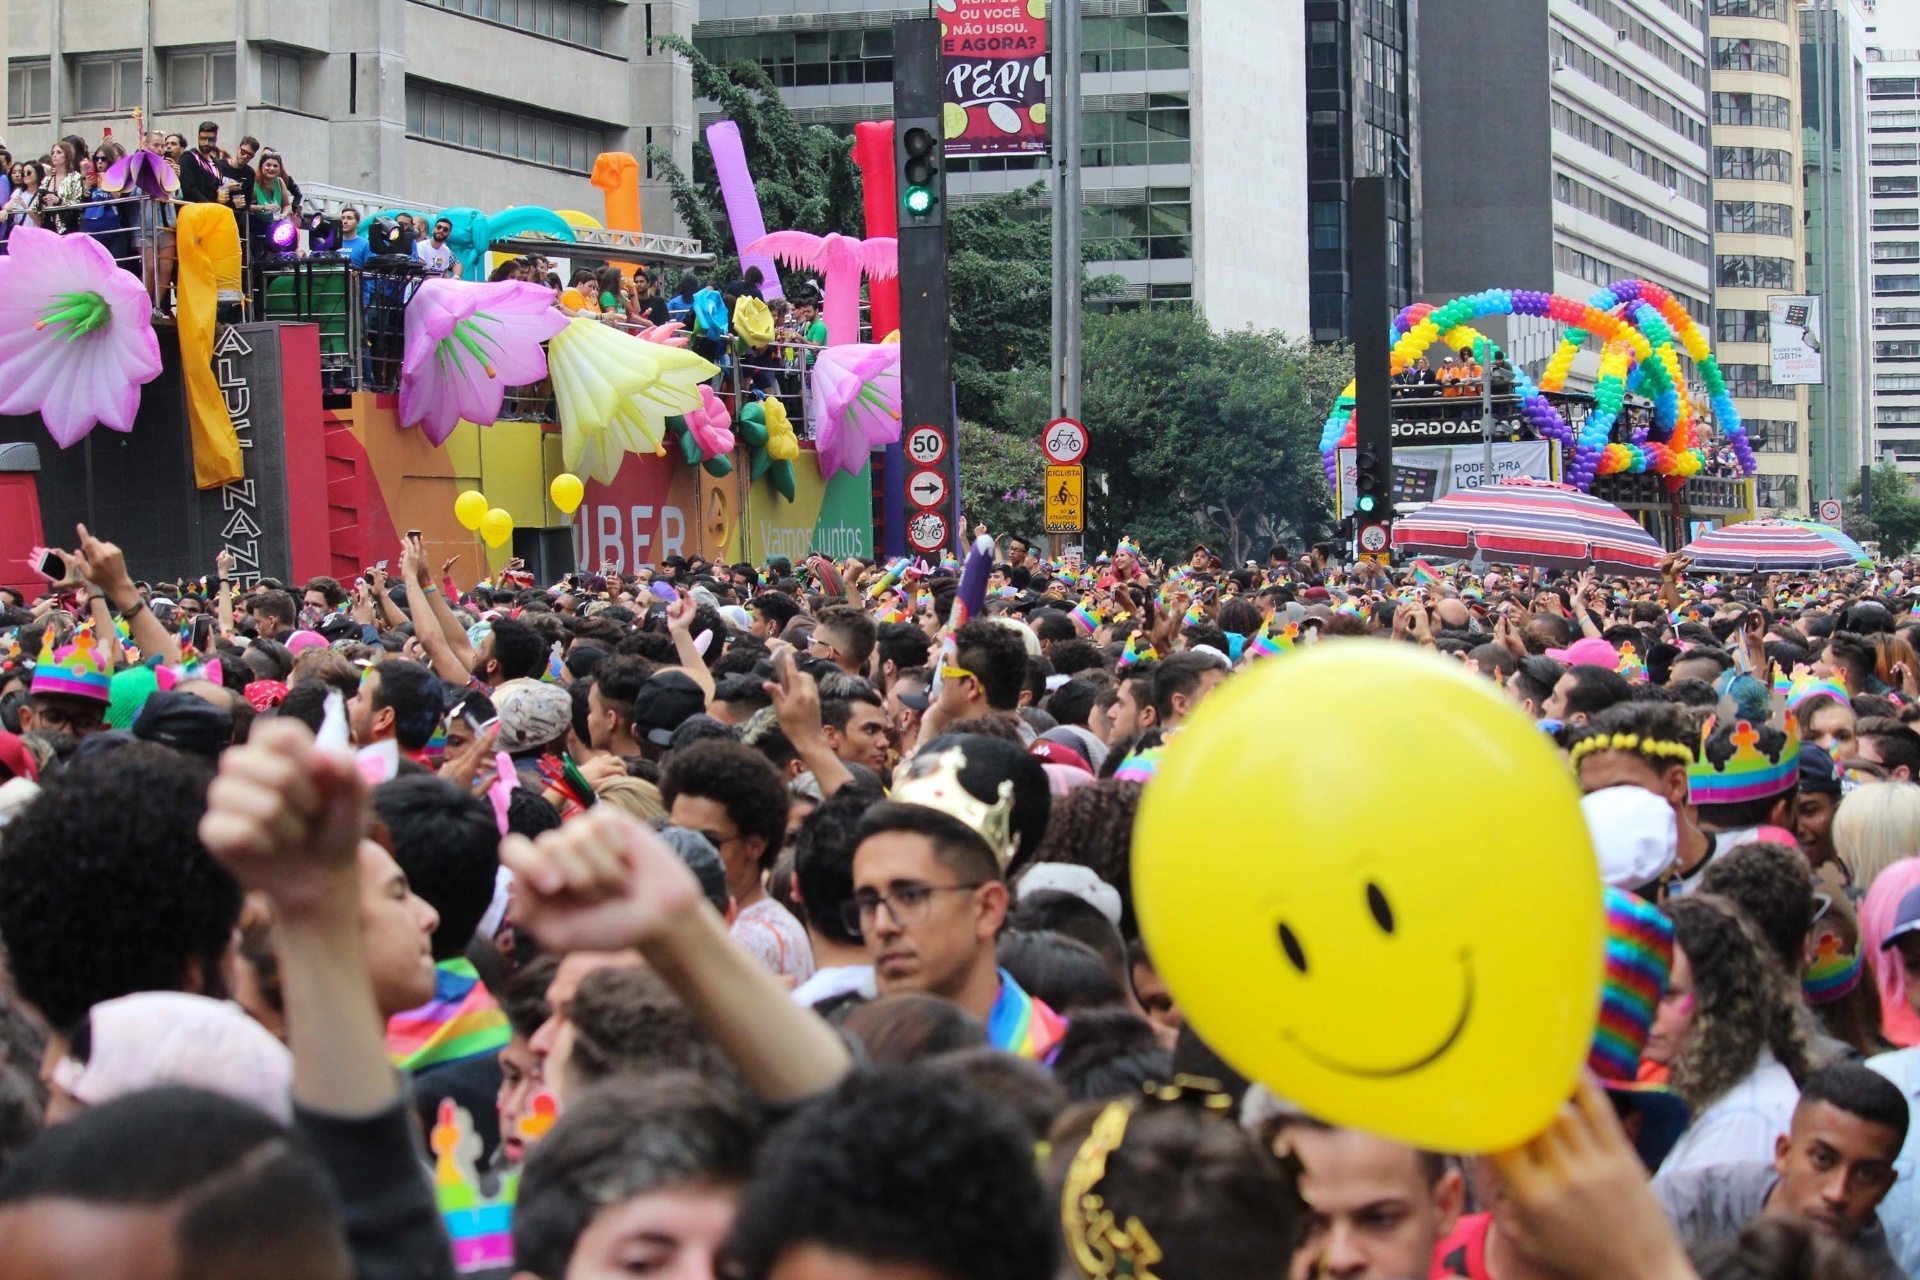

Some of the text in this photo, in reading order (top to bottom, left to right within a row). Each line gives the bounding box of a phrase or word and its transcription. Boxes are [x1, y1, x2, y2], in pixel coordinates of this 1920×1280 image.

[960, 9, 980, 20] OU
[983, 6, 1021, 19] VOCÊ
[952, 22, 1028, 36] NÃO USOU.
[944, 36, 1038, 52] E AGORA?
[945, 60, 1030, 98] PEP!
[1773, 352, 1803, 360] LGBTI+
[913, 434, 940, 453] 50
[1047, 469, 1081, 477] CICLISTA
[1498, 461, 1521, 471] PRA
[561, 503, 685, 575] UBER
[760, 517, 863, 558] Vamos juntos
